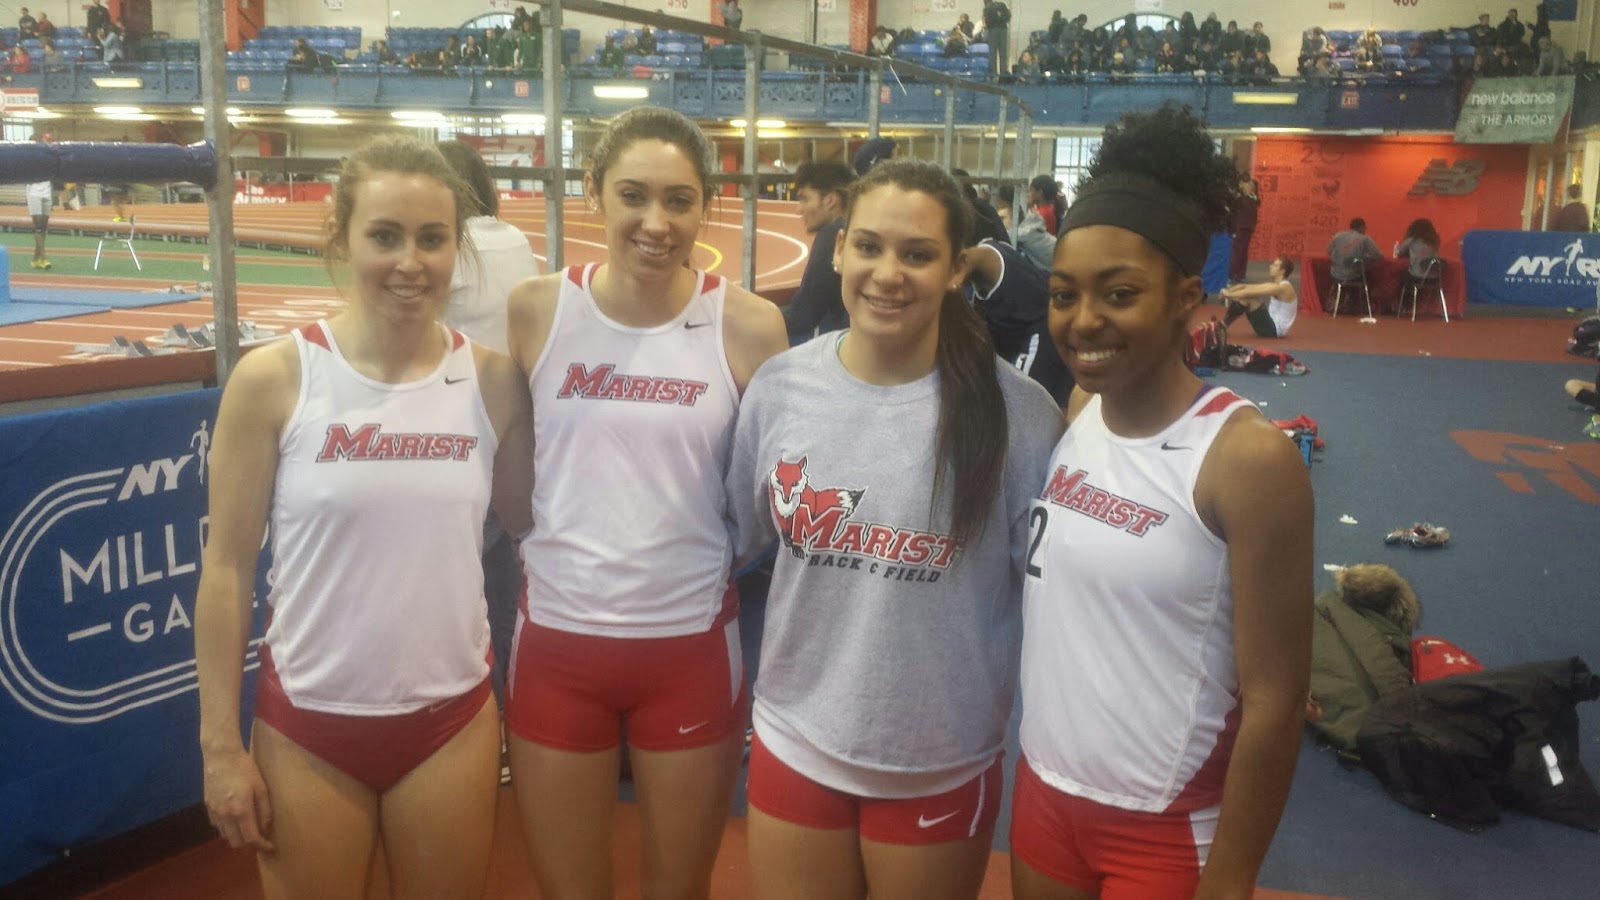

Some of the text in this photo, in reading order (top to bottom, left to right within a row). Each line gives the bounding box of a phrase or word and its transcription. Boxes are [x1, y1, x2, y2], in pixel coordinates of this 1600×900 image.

[1471, 91, 1556, 105] new balance
[1481, 114, 1502, 126] THE
[1504, 114, 1555, 126] ARMORY
[1506, 255, 1565, 276] NY
[556, 362, 708, 407] MARIST
[315, 422, 478, 464] MARIST
[117, 453, 195, 502] NY
[803, 552, 865, 571] RACK
[882, 566, 943, 584] FIELD
